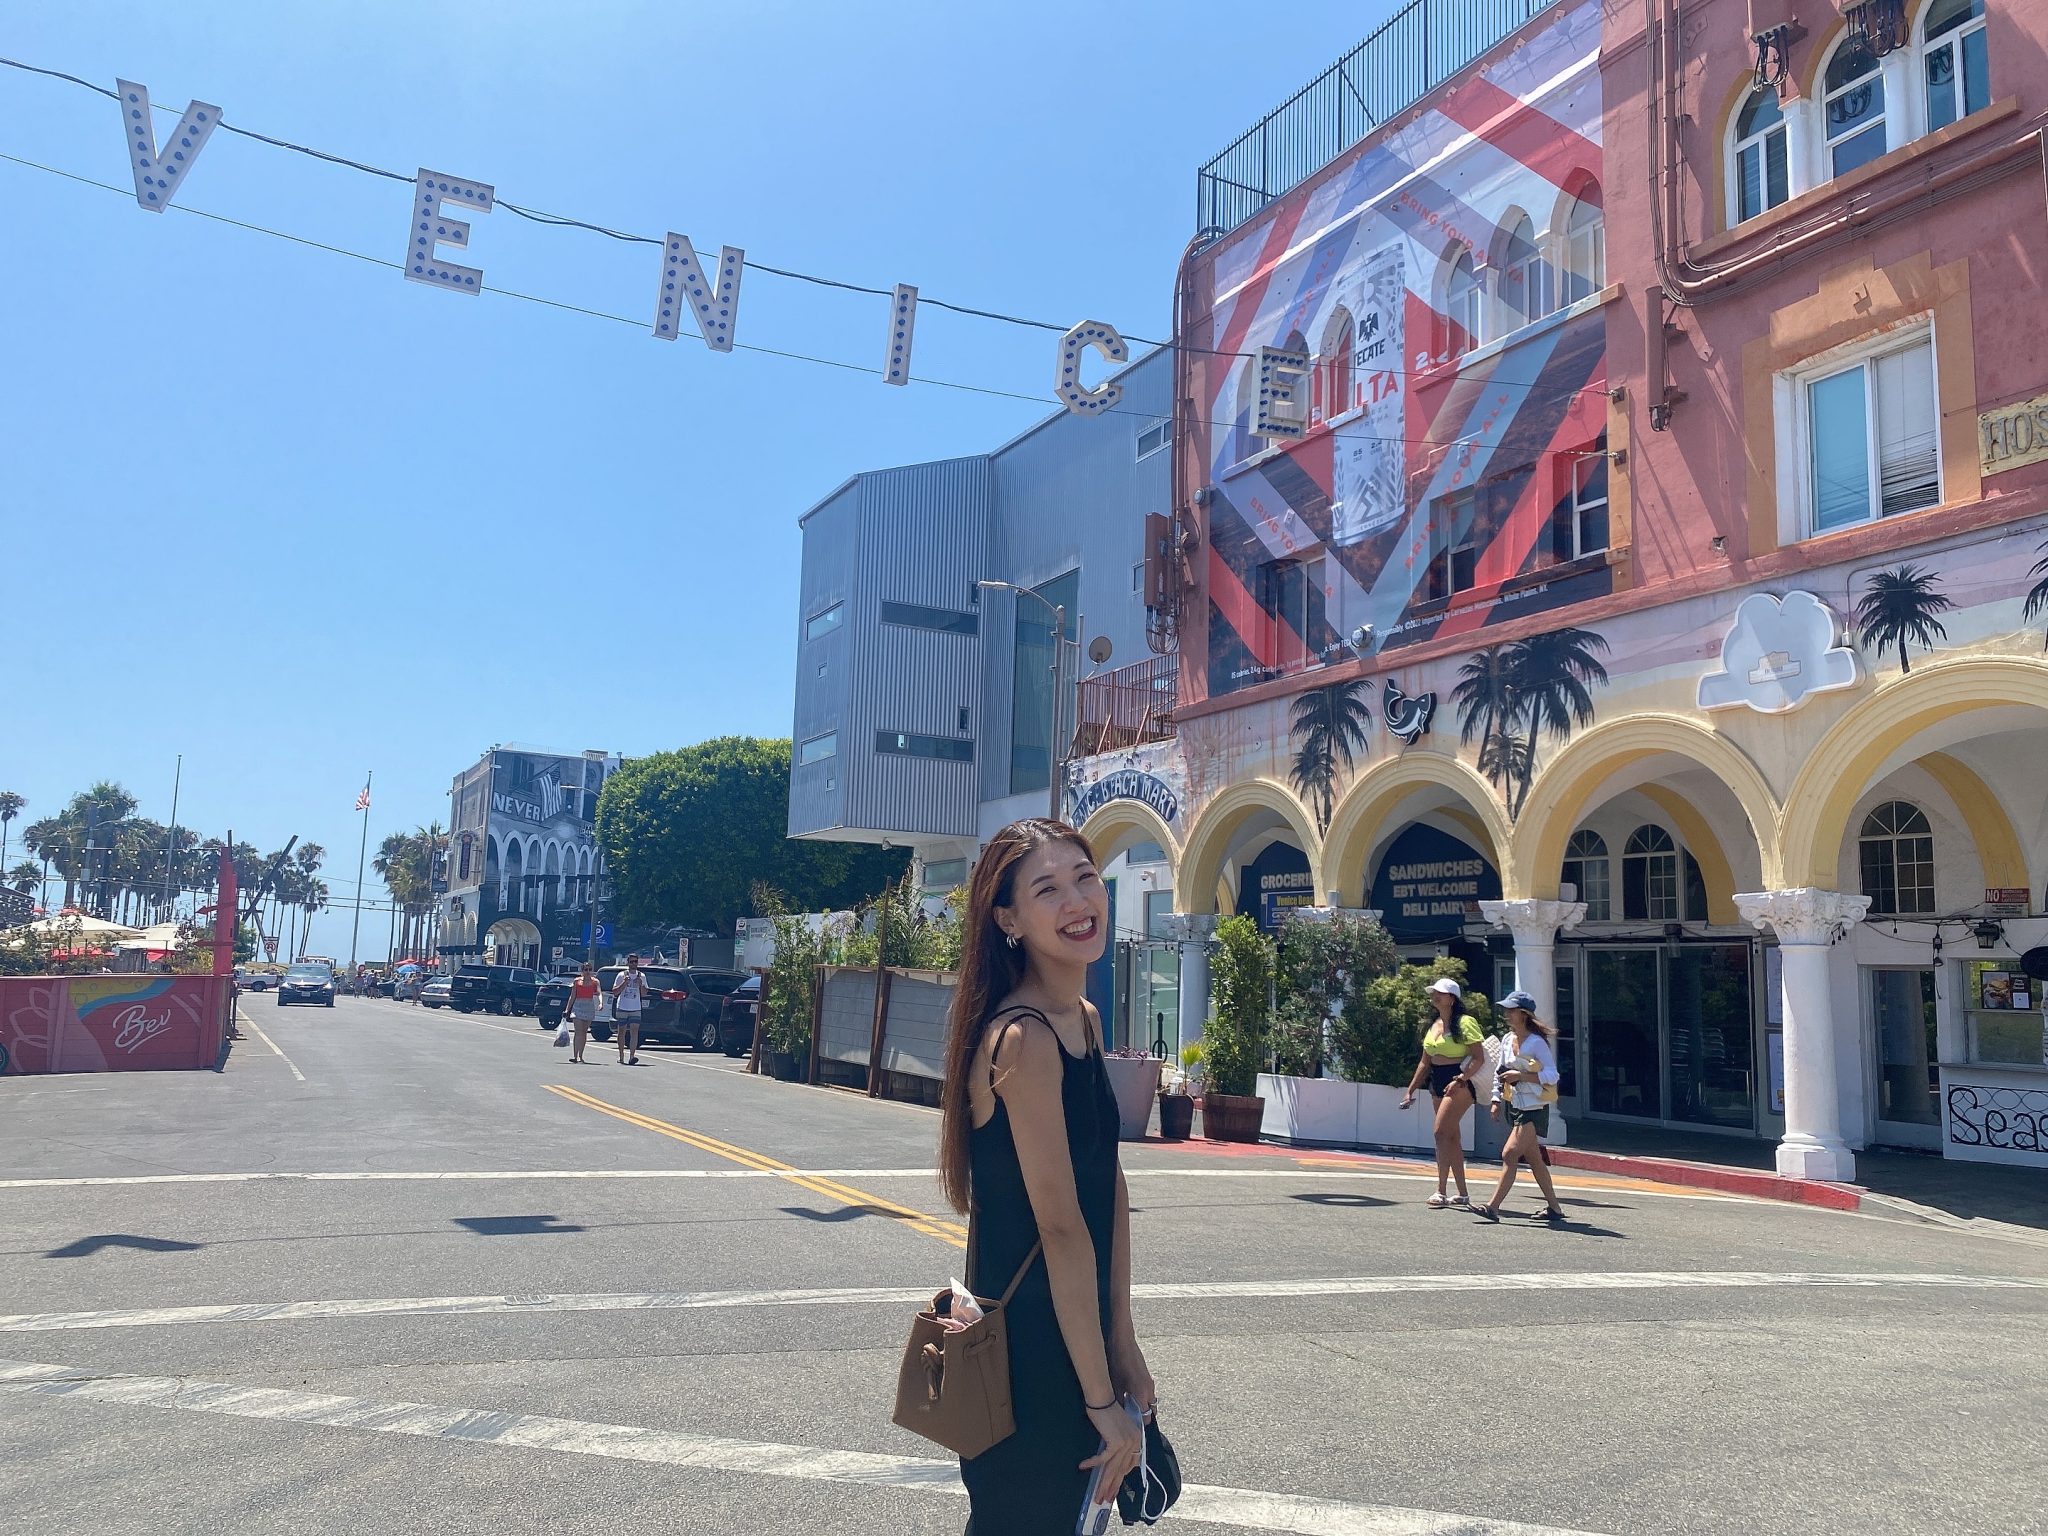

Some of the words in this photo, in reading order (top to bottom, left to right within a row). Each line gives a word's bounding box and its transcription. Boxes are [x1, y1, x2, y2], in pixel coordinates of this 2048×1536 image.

[1400, 190, 1439, 226] BRING
[116, 78, 1310, 439] VENICE
[1355, 367, 1399, 408] LTA
[492, 792, 542, 822] NEVER
[1101, 773, 1138, 801] BEACH
[1142, 777, 1177, 819] MART
[1389, 859, 1483, 880] SANDWICHES
[1393, 884, 1416, 898] EBT
[1417, 881, 1478, 896] WELCOME
[1986, 889, 1999, 902] NO
[1403, 902, 1428, 916] DELI
[113, 1005, 171, 1049] Bev
